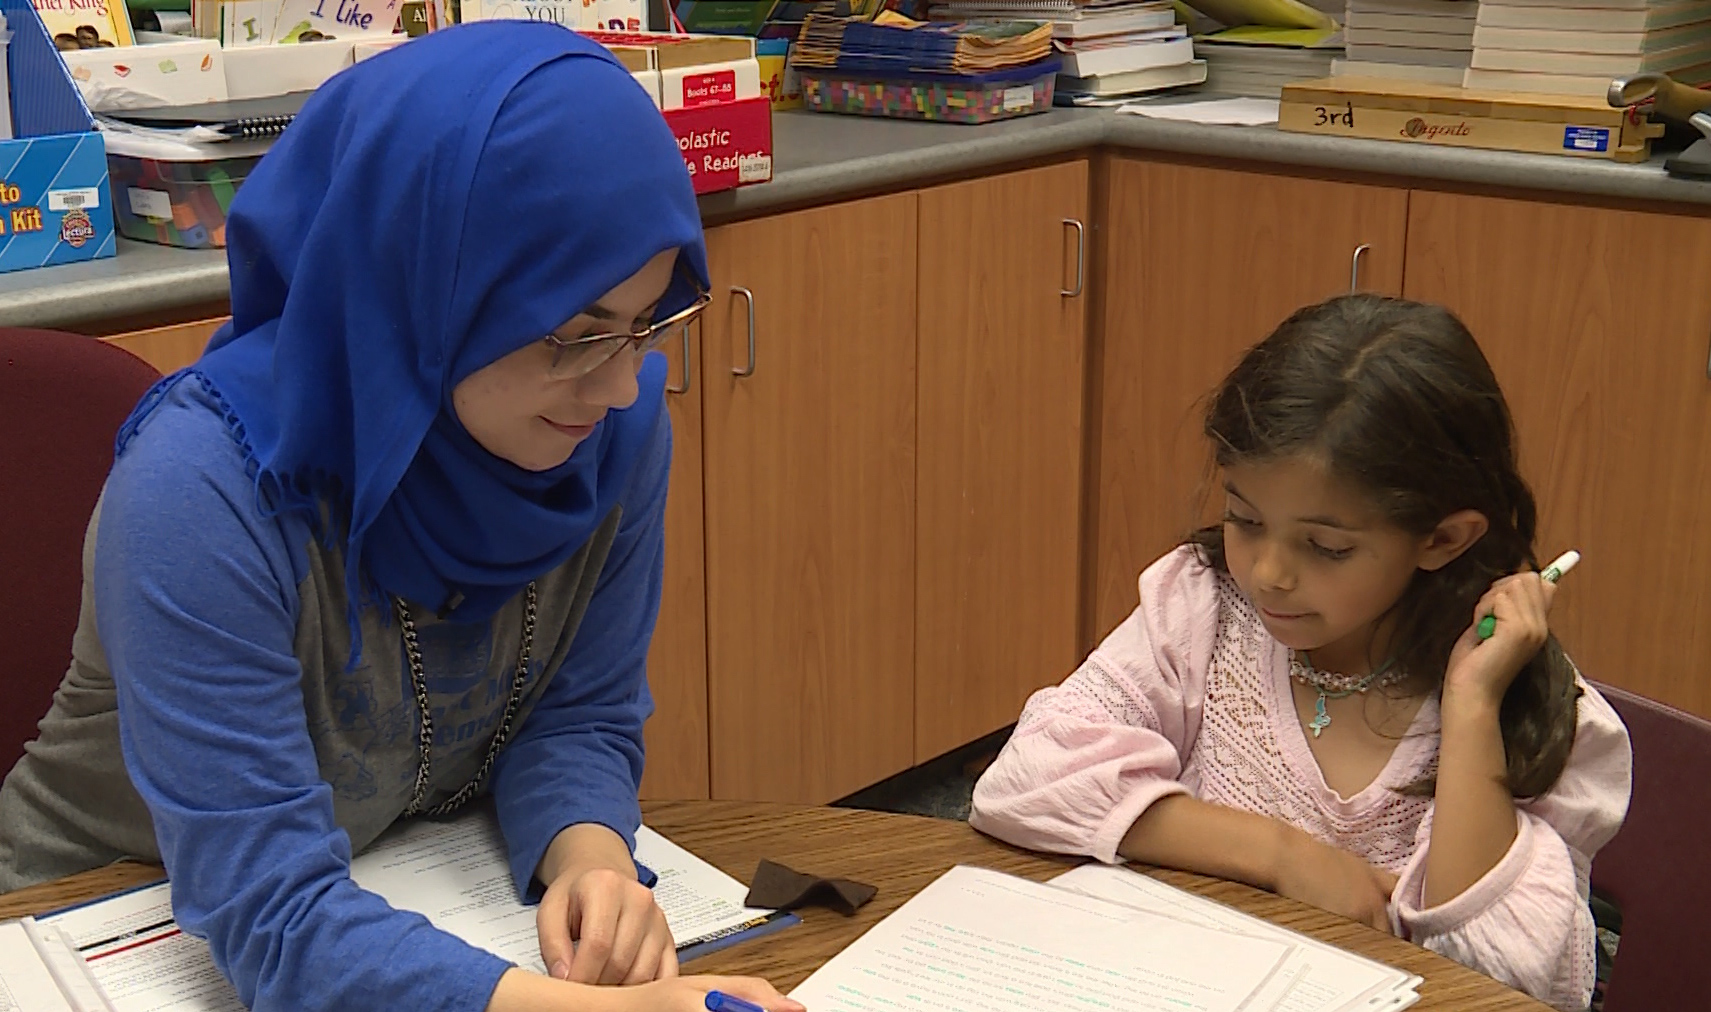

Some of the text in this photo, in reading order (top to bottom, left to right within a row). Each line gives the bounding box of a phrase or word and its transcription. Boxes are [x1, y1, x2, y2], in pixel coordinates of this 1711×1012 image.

[525, 6, 566, 24] YOU
[1314, 101, 1354, 128] 3rd
[703, 150, 763, 172] Read
[12, 209, 42, 232] Kit
